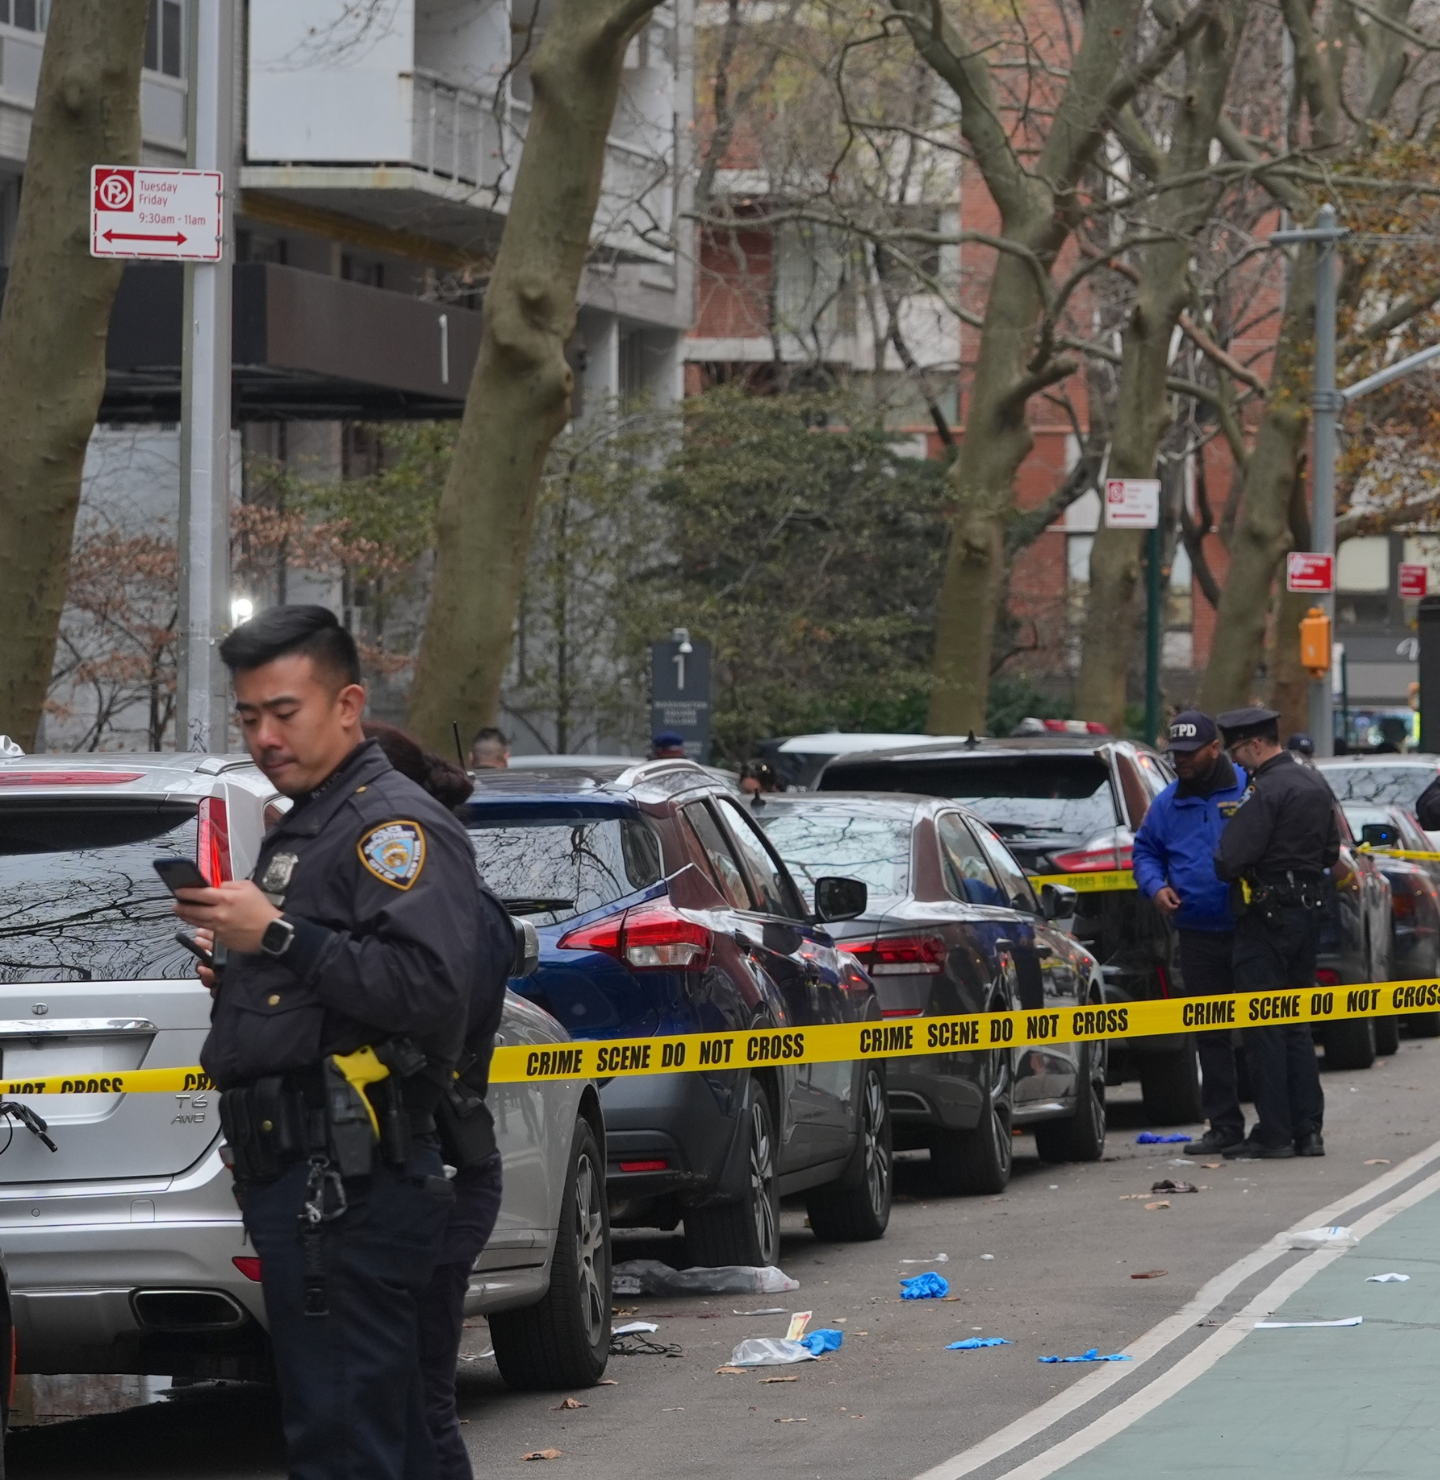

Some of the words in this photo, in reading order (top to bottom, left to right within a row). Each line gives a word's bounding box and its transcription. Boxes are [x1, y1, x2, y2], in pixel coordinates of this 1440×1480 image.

[140, 180, 178, 194] Tuesday
[139, 194, 168, 208] Friday
[139, 212, 175, 224] 9:30am
[184, 214, 206, 226] 11am
[671, 653, 686, 691] 1
[526, 1049, 583, 1077] CRIME
[596, 1045, 651, 1072] SCENE
[661, 1042, 686, 1068] DO
[699, 1039, 734, 1065] NOT
[746, 1033, 805, 1062] CROSS
[859, 1025, 913, 1053] CRIME
[927, 1020, 979, 1048] SCENE
[990, 1017, 1013, 1043] DO
[1027, 1014, 1059, 1039] NOT
[1072, 1008, 1129, 1036] CROSS
[1182, 999, 1236, 1027] CRIME
[1248, 994, 1301, 1021] SCENE
[1310, 992, 1334, 1016] DO
[1347, 988, 1381, 1013] NOT
[175, 1093, 208, 1109] T6
[171, 1112, 206, 1124] AWD
